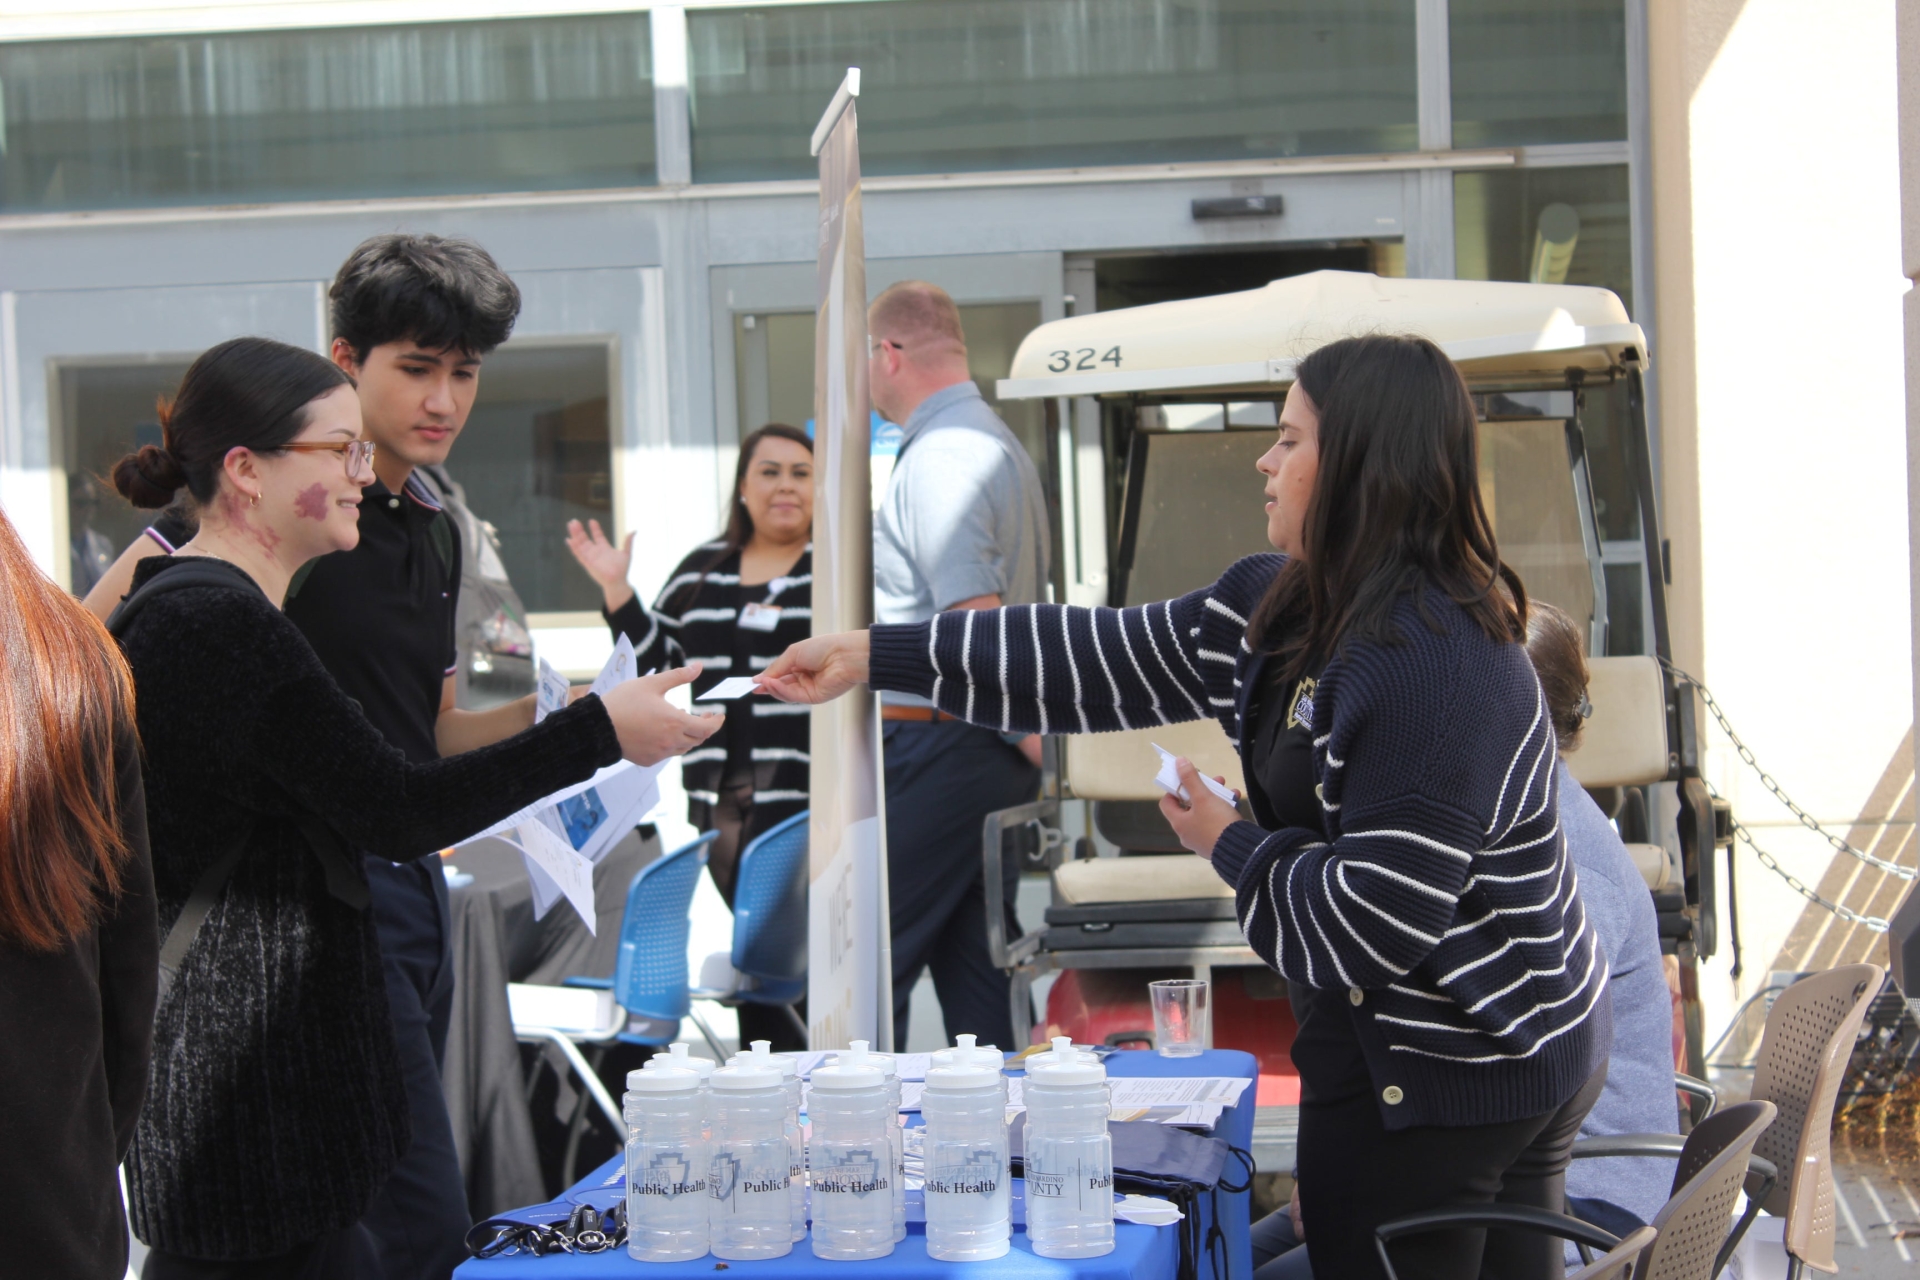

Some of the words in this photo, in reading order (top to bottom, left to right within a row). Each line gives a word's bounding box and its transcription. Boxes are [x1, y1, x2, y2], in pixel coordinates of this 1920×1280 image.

[1047, 345, 1123, 373] 324
[632, 1182, 669, 1195] Public
[672, 1179, 706, 1195] Health
[743, 1180, 782, 1193] Public
[813, 1179, 847, 1193] Public
[851, 1177, 888, 1193] Health
[953, 1179, 996, 1194] Health
